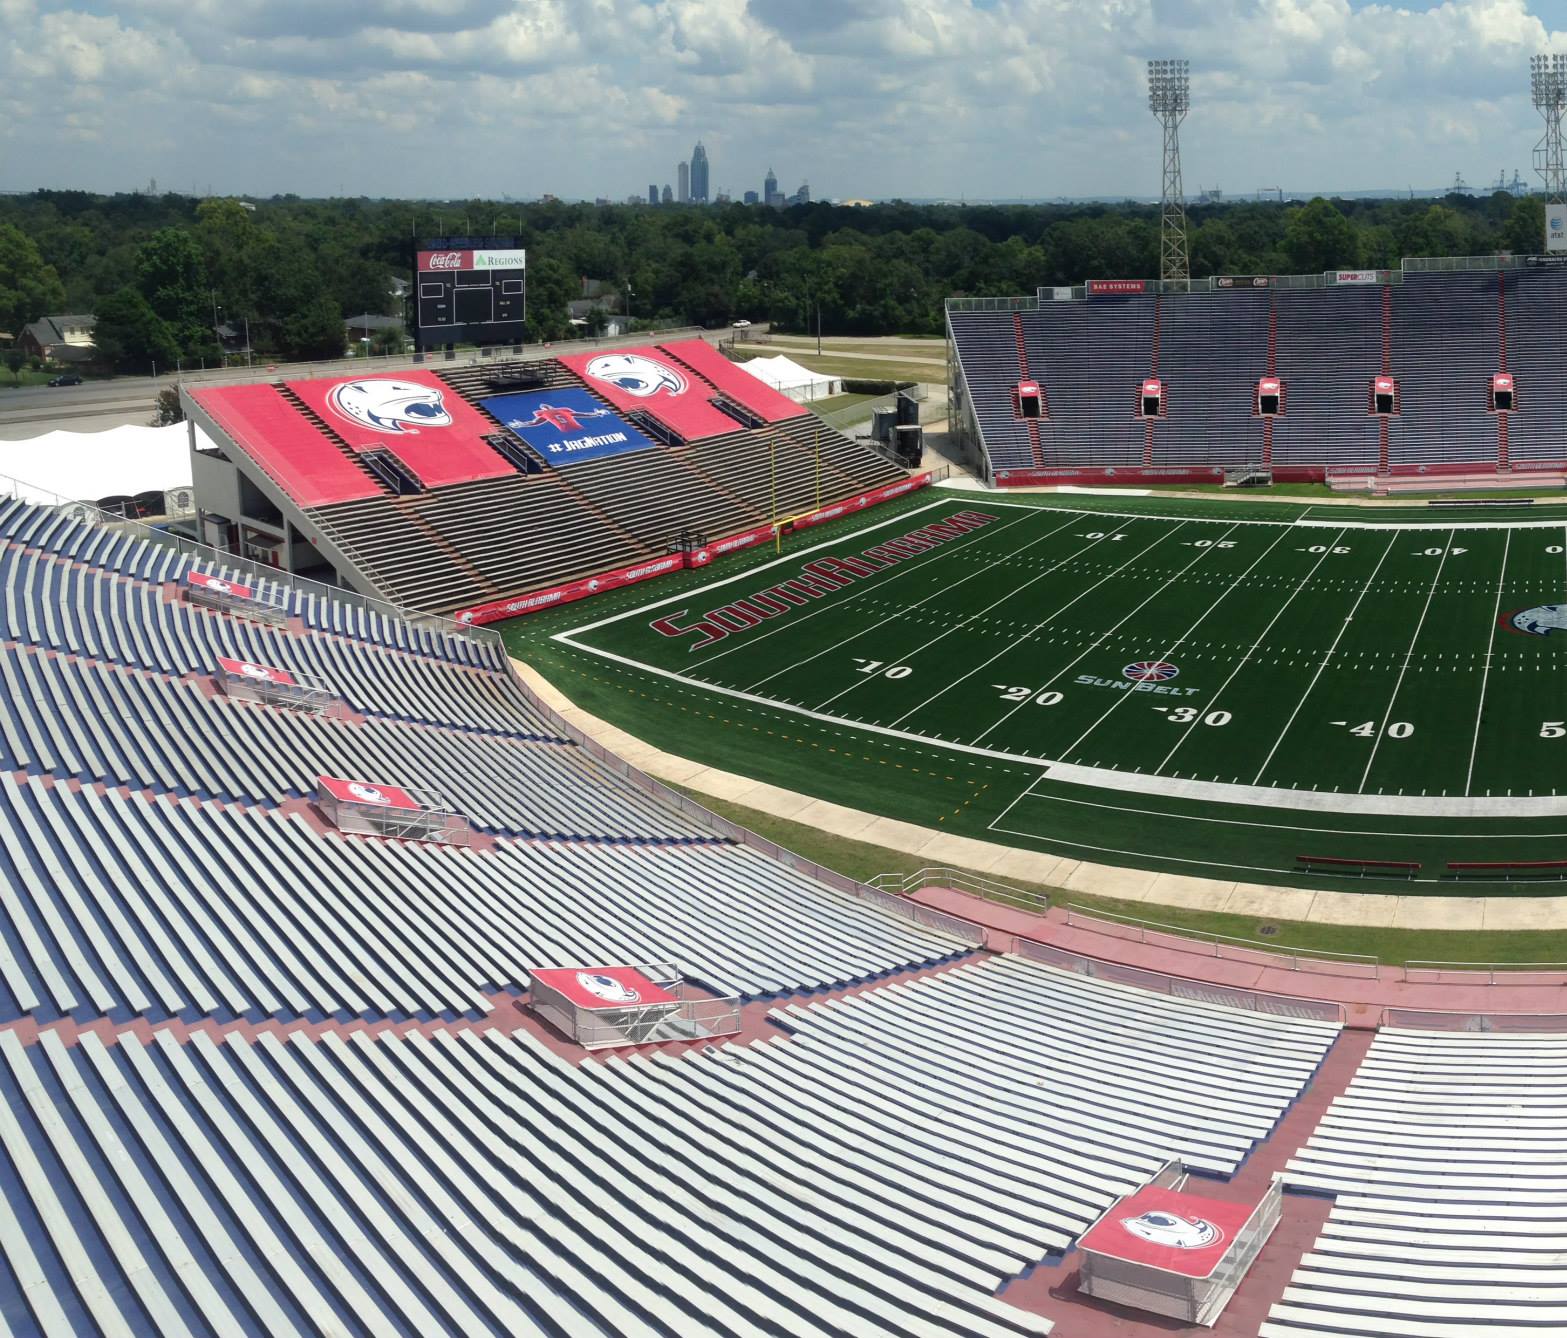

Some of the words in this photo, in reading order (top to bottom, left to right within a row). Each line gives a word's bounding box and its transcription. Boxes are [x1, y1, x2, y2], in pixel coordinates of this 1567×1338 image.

[855, 660, 913, 679] 10
[1074, 675, 1132, 690] SUN
[1135, 682, 1200, 696] BELT
[999, 686, 1064, 706] 20
[1166, 707, 1233, 728] 30
[1349, 721, 1415, 739] 40
